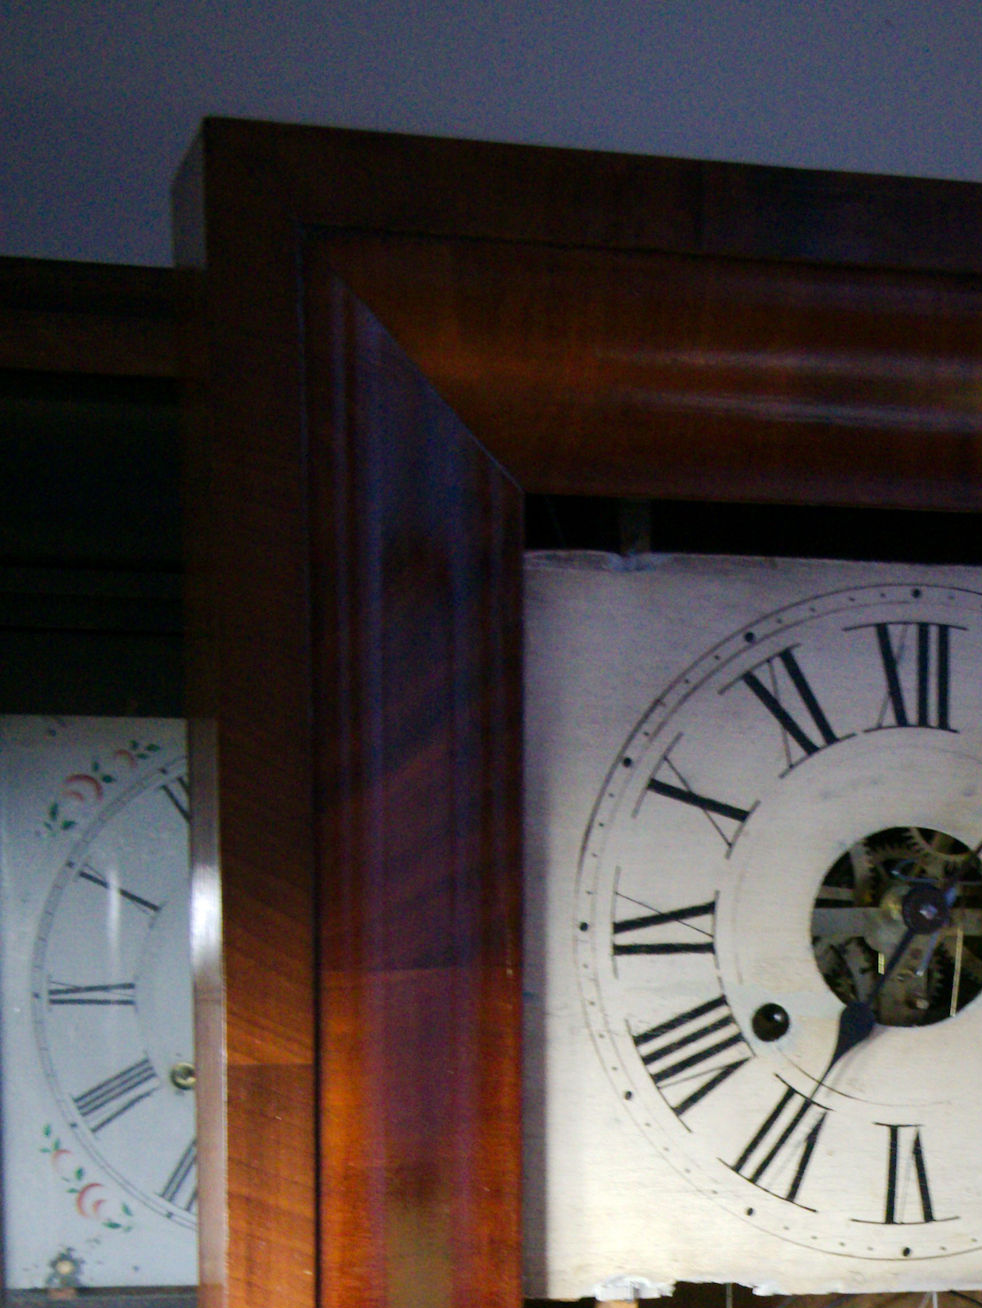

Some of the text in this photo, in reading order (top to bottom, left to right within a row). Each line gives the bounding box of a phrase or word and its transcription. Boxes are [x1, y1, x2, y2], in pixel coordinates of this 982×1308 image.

[716, 643, 858, 779] XI
[842, 620, 969, 735] XII
[631, 731, 762, 860] X
[610, 865, 721, 980] IX
[624, 975, 757, 1133] VIII
[717, 1073, 835, 1214] VII
[850, 1121, 961, 1226] VI
